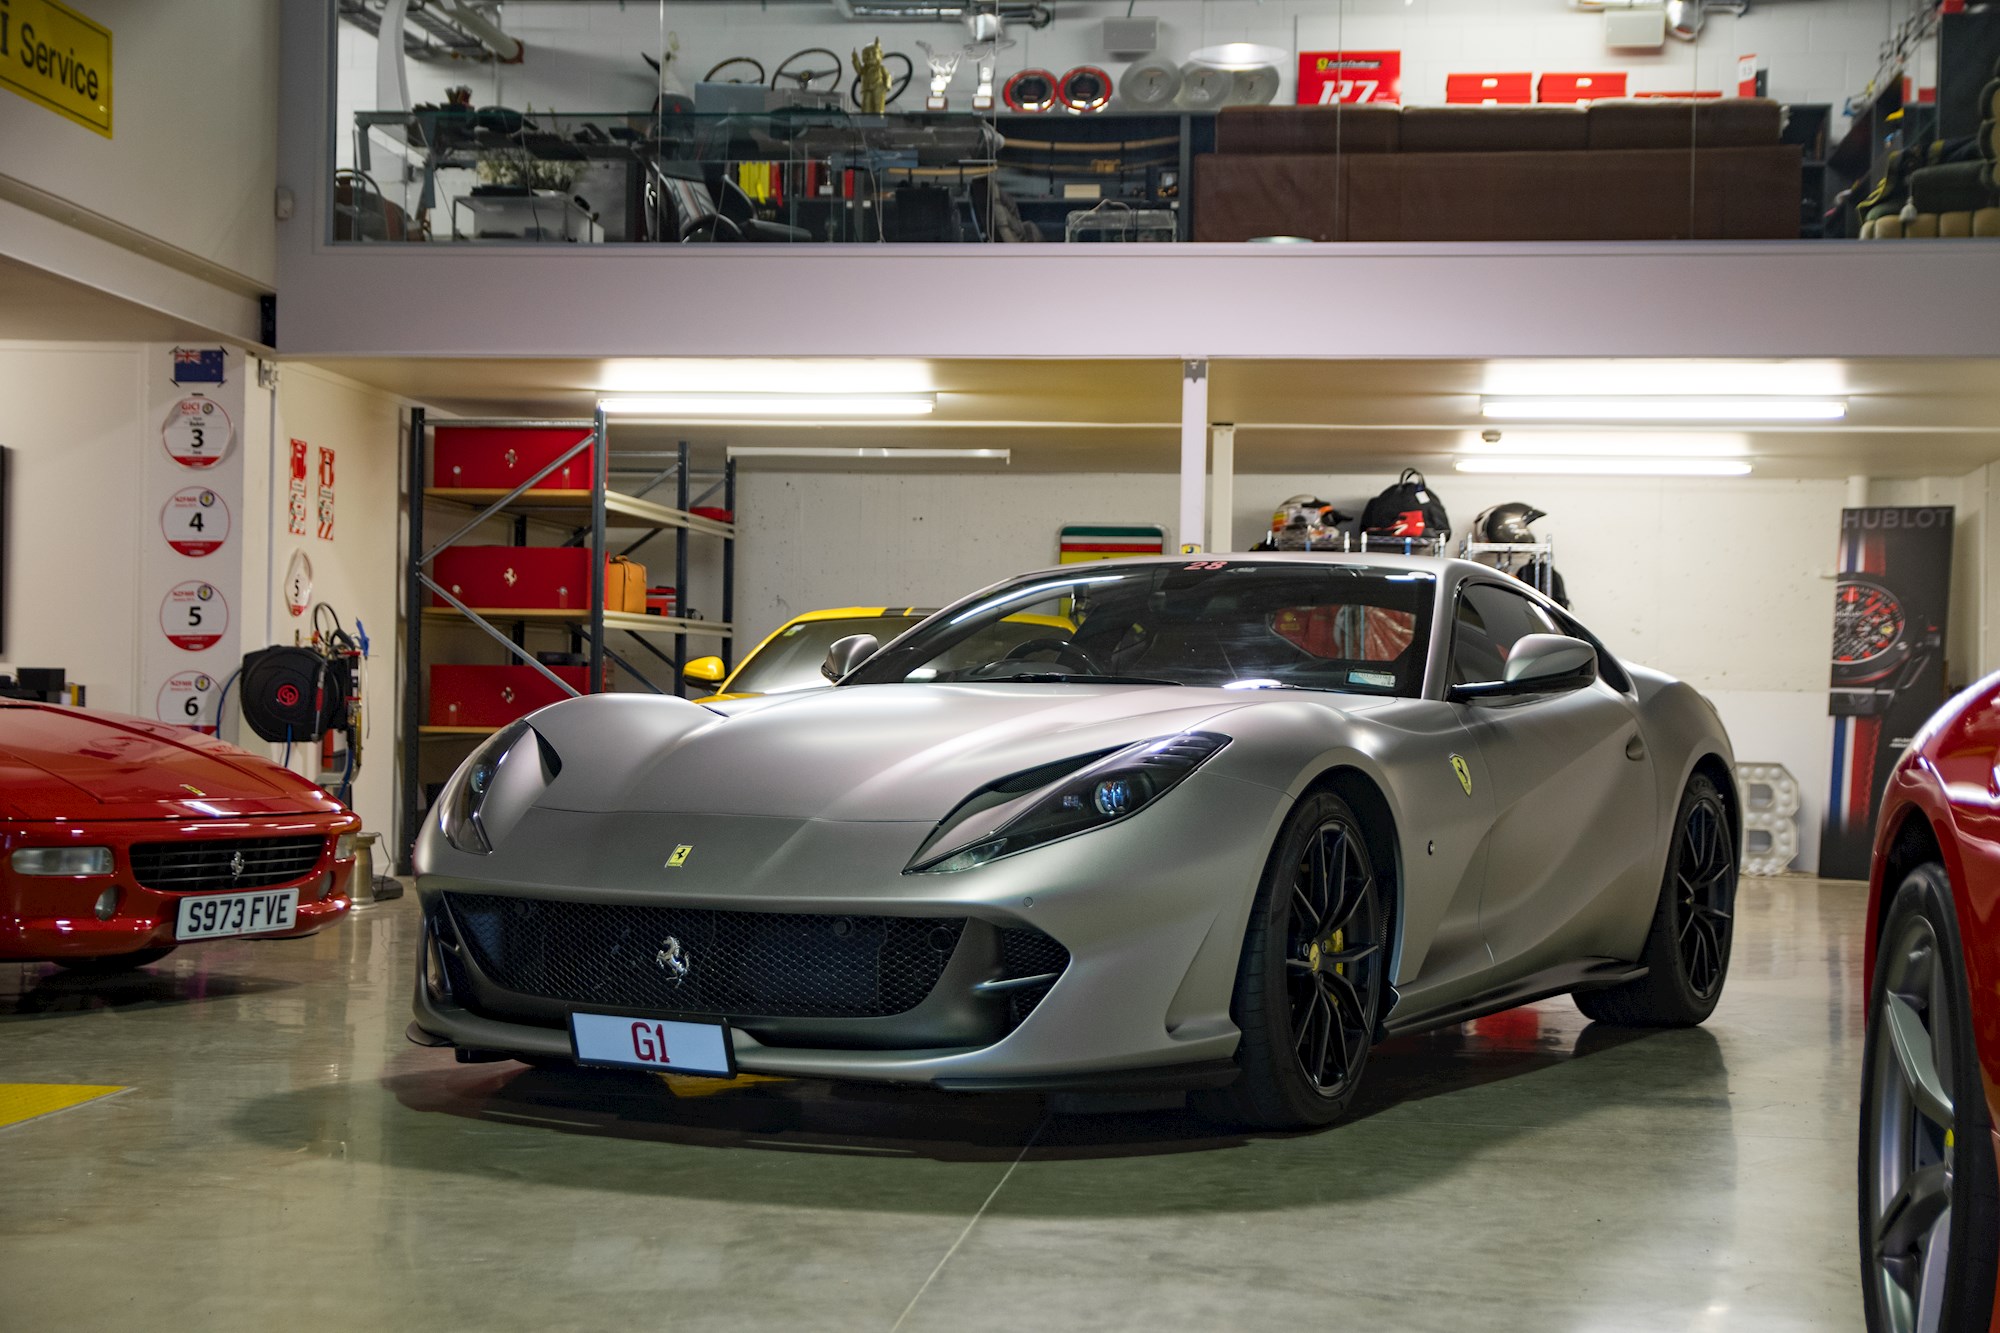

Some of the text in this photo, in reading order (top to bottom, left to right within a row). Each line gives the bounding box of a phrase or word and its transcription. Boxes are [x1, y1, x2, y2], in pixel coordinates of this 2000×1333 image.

[20, 22, 99, 101] Service
[191, 428, 204, 448] 3
[189, 512, 204, 532] 4
[1843, 508, 1952, 528] HUBLOT
[1184, 560, 1228, 570] 28
[188, 606, 202, 626] 5
[184, 696, 199, 716] 6
[188, 894, 290, 933] S973 FVE
[631, 1021, 670, 1063] G1
